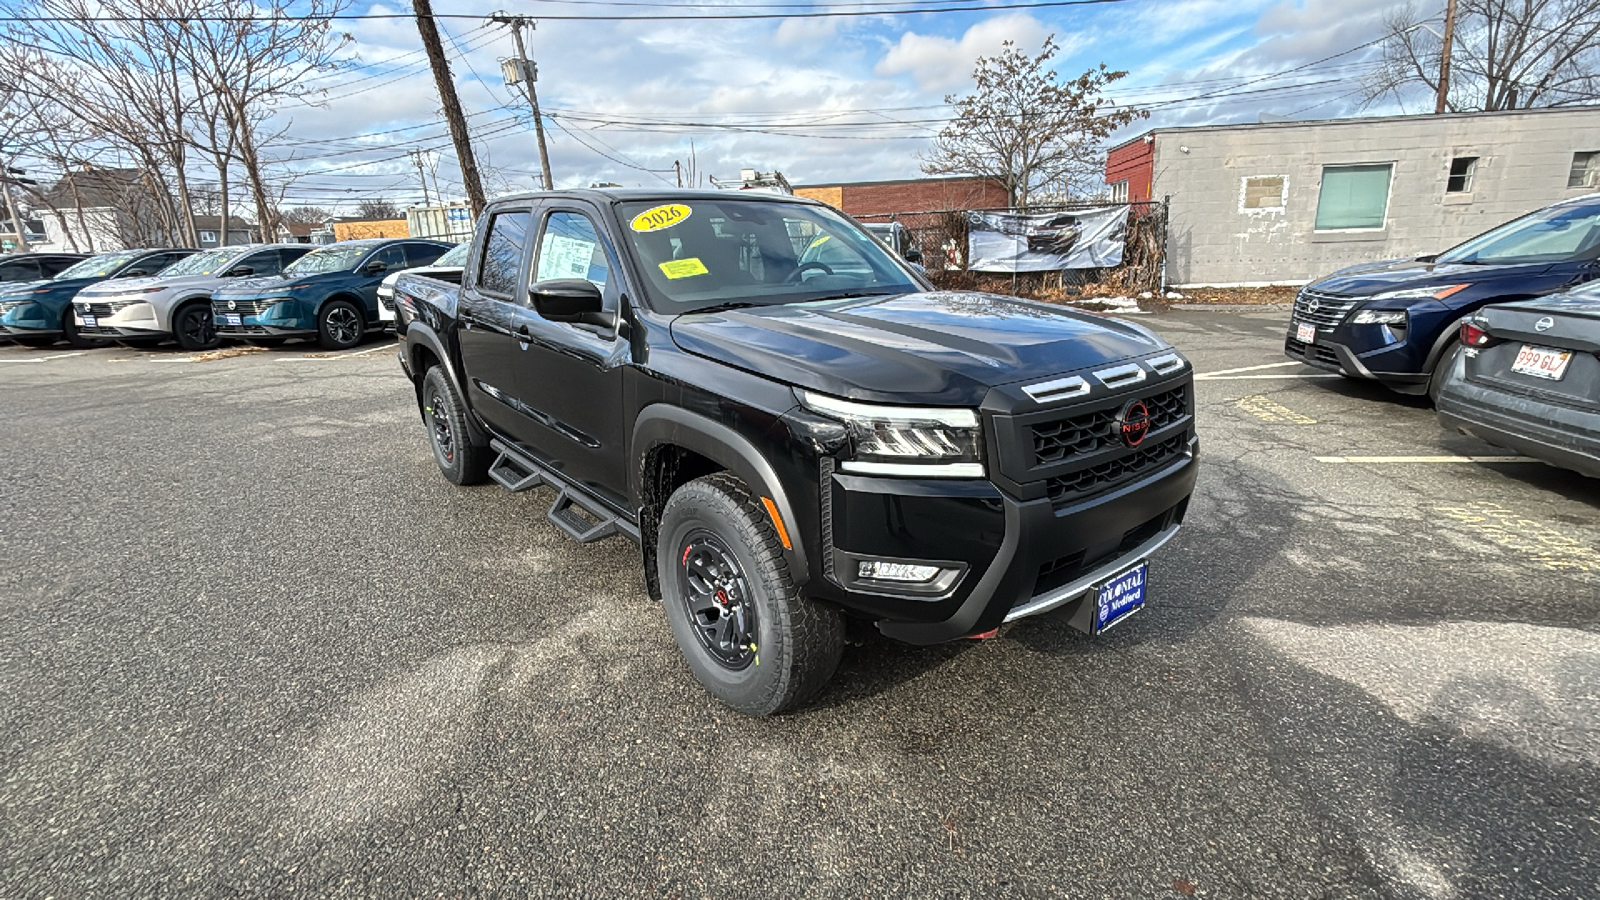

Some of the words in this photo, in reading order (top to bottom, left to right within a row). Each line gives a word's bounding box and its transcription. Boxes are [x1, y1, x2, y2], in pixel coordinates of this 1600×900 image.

[642, 207, 681, 228] 2026
[1517, 351, 1540, 367] 999
[1098, 573, 1143, 607] COLONIAL
[1111, 588, 1141, 611] Medford
